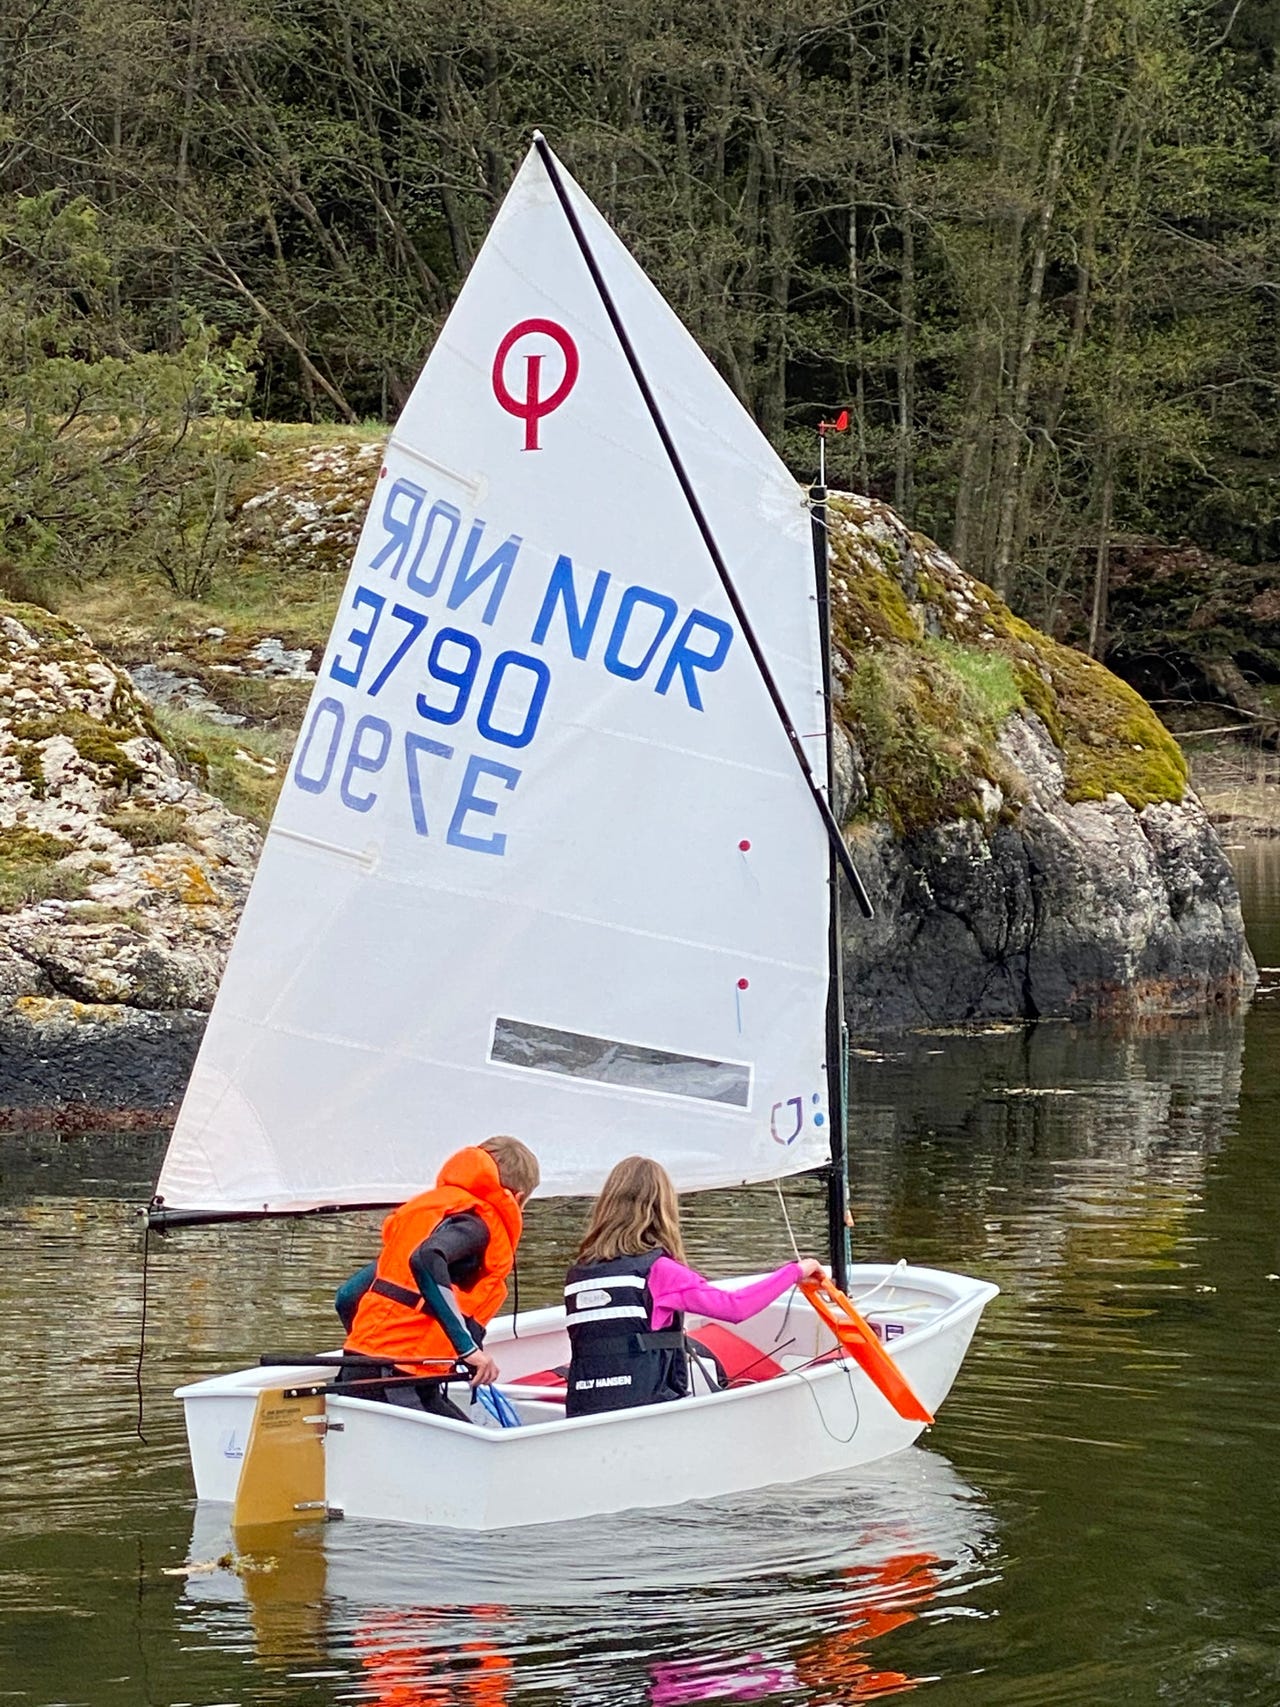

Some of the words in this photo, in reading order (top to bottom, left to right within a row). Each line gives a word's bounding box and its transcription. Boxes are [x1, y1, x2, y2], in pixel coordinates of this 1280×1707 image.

[329, 585, 552, 750] 3790
[530, 554, 734, 713] NOR
[595, 1375, 632, 1388] HANSEN
